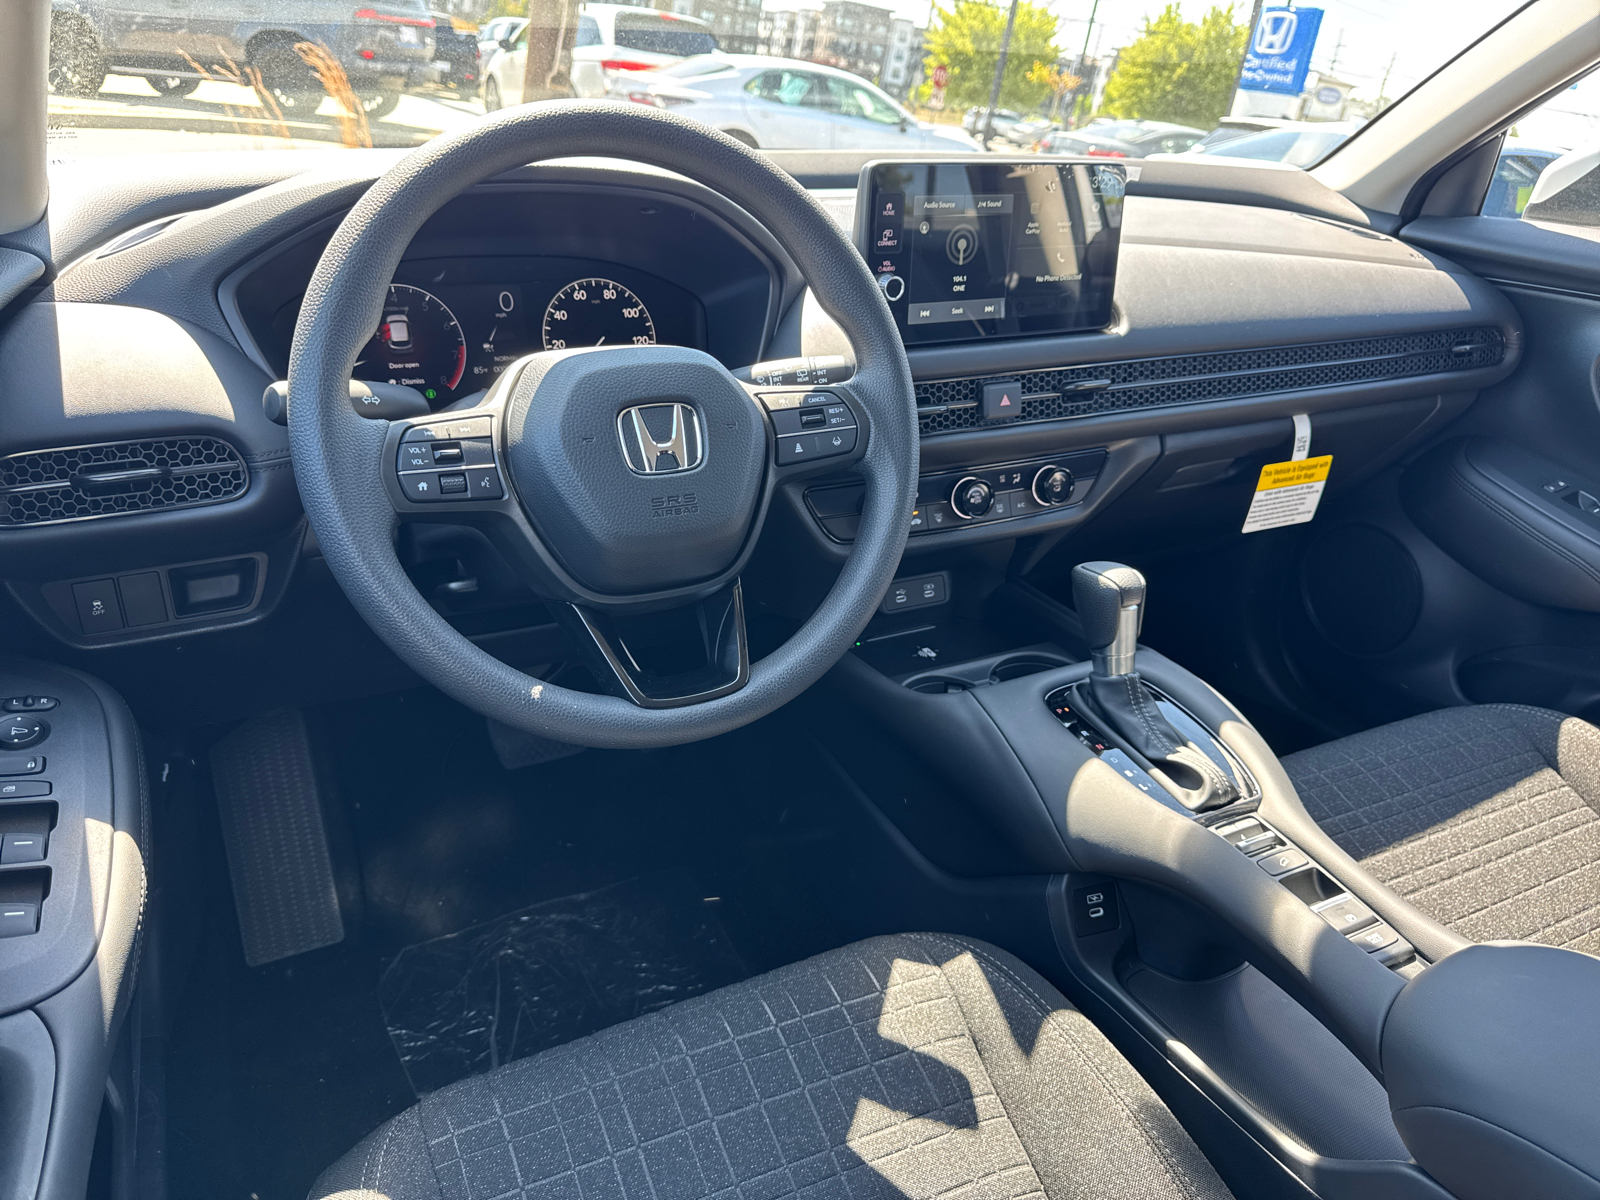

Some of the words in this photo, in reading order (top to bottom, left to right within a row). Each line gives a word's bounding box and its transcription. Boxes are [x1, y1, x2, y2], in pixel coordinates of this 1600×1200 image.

[924, 201, 938, 209] Audio
[987, 200, 1002, 208] Sound
[952, 275, 967, 283] 104.1
[1035, 275, 1044, 283] No
[1060, 273, 1082, 281] Detected
[952, 284, 966, 292] ONE
[391, 293, 398, 303] 4
[573, 289, 587, 300] 60
[603, 289, 617, 300] 80
[499, 291, 514, 312] 0
[422, 302, 429, 312] 5
[951, 307, 964, 315] Seek
[553, 310, 568, 321] 40
[622, 308, 640, 319] 100
[443, 321, 451, 331] 6
[551, 339, 566, 350] 20
[632, 335, 649, 346] 120
[452, 350, 458, 360] 7
[388, 362, 404, 370] Door
[404, 362, 420, 370] open
[401, 377, 425, 385] Dismiss
[440, 375, 447, 385] 8
[1273, 466, 1291, 475] Vehicle
[1297, 461, 1319, 472] Equipped
[1271, 474, 1295, 484] Advanced
[651, 492, 697, 507] SRS
[652, 505, 699, 519] AIRBAG
[1138, 783, 1148, 791] L
